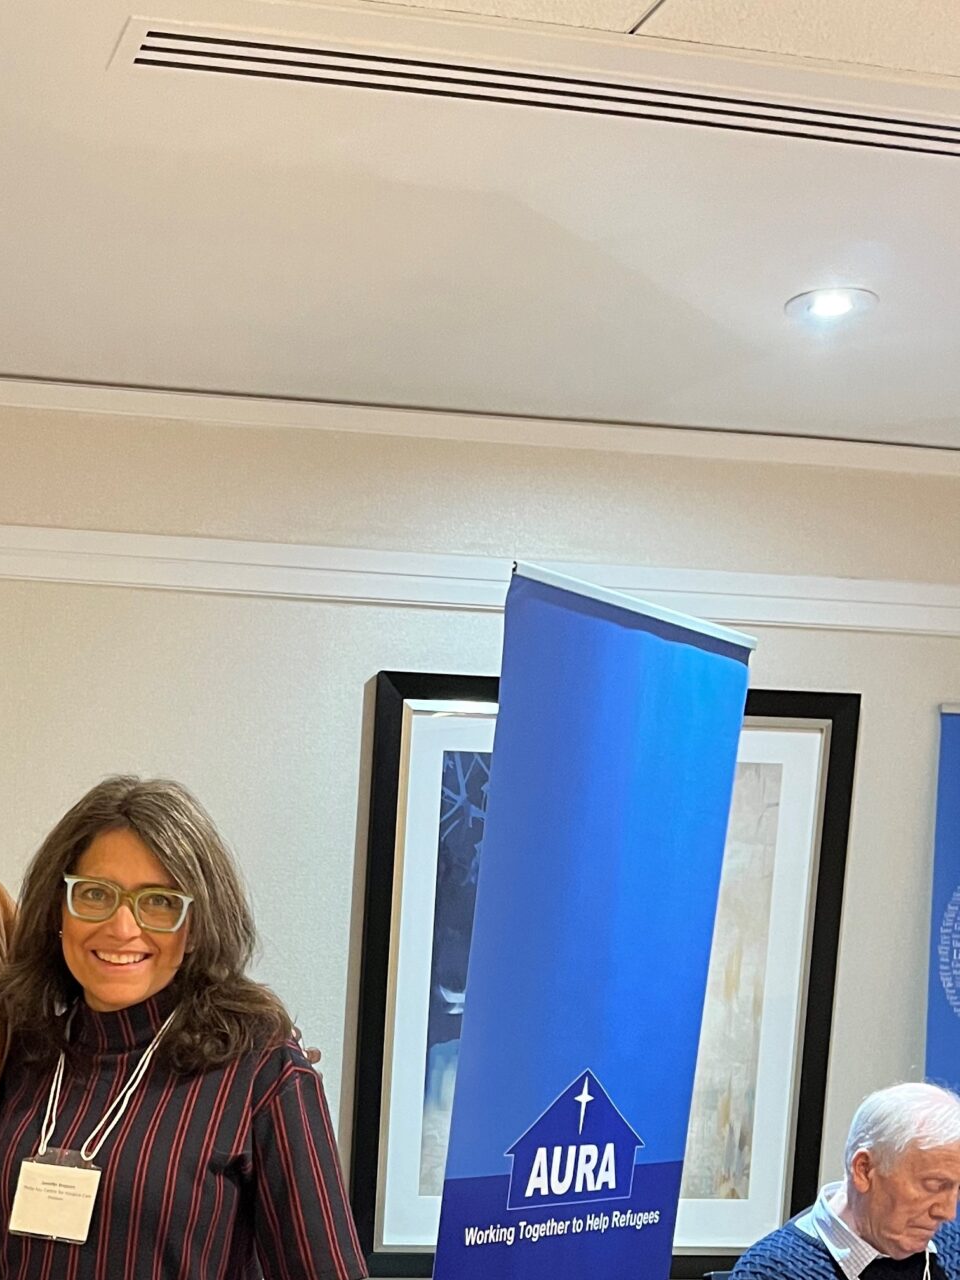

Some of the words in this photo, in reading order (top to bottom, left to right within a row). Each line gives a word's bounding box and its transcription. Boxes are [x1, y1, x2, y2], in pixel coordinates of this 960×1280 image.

[524, 1142, 616, 1198] AURA
[464, 1225, 515, 1247] Working
[518, 1218, 571, 1242] Together
[572, 1218, 583, 1234] to
[586, 1212, 609, 1233] Help
[611, 1209, 660, 1231] Refugees
